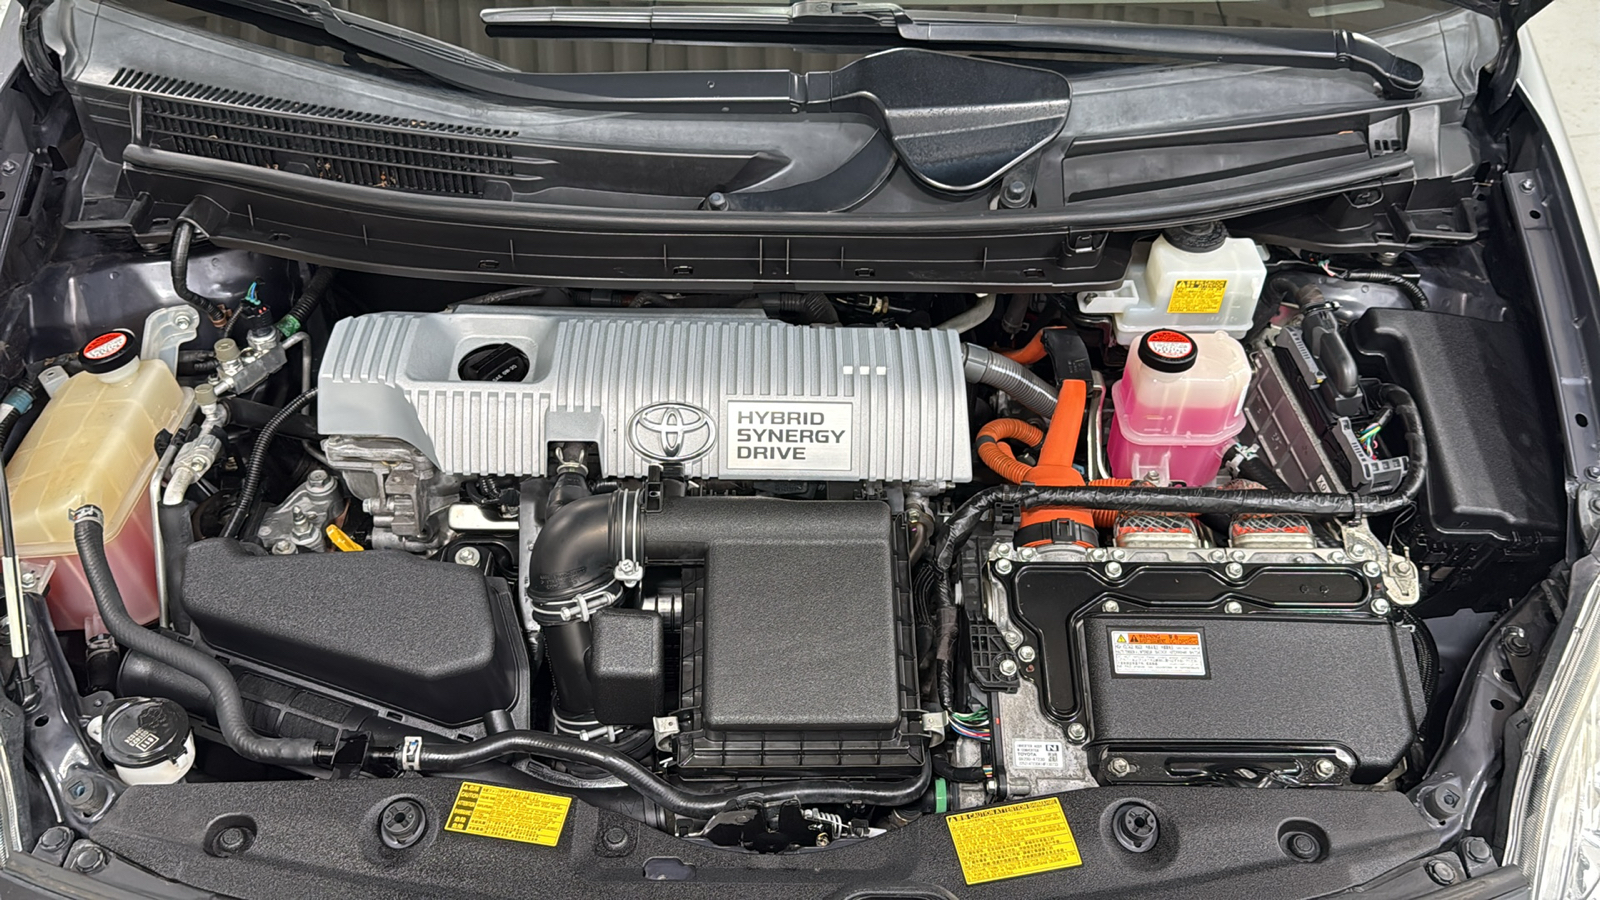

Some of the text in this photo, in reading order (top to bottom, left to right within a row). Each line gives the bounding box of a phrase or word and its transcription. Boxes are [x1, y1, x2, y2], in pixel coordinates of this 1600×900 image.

[738, 411, 825, 425] HYBRID
[737, 428, 846, 444] SYNERGY
[737, 446, 806, 460] DRIVE
